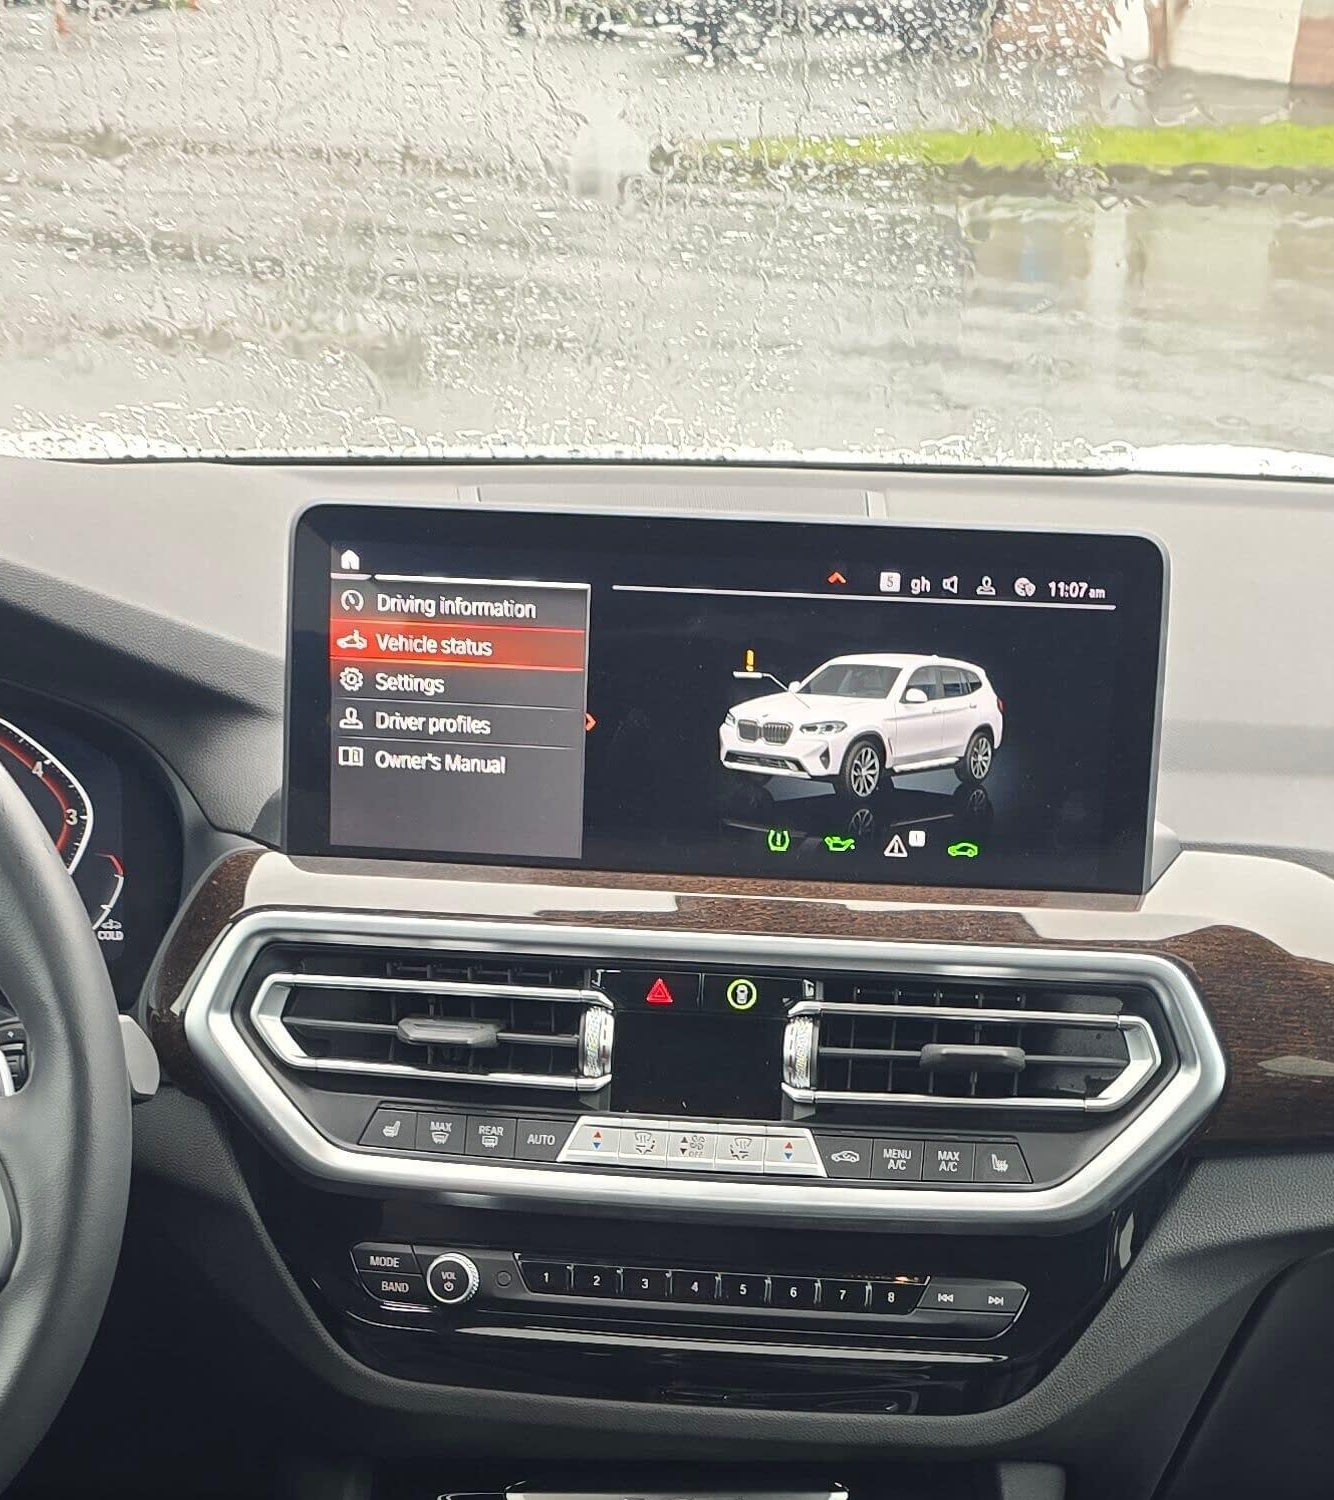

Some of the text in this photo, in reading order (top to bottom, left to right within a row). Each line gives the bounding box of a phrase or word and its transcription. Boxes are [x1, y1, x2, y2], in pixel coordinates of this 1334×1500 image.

[911, 575, 931, 594] gh
[376, 593, 537, 619] Driving information
[375, 633, 493, 657] Vehicle status
[375, 672, 445, 696] Settings
[375, 711, 492, 736] Driver profiles
[32, 761, 44, 778] 4
[375, 752, 506, 774] Owner's Manual
[66, 809, 79, 826] 3
[429, 1120, 453, 1134] MAX
[477, 1124, 505, 1137] REAR
[526, 1133, 556, 1147] AUTO
[882, 1148, 912, 1160] MENU
[937, 1149, 960, 1162] MAX
[887, 1159, 907, 1172] A/C
[938, 1160, 958, 1173] A/C
[369, 1255, 400, 1268] MODE
[441, 1270, 457, 1281] VOL
[380, 1281, 410, 1294] BAND
[543, 1271, 896, 1304] 1 2 3 4 5 6 7 8
